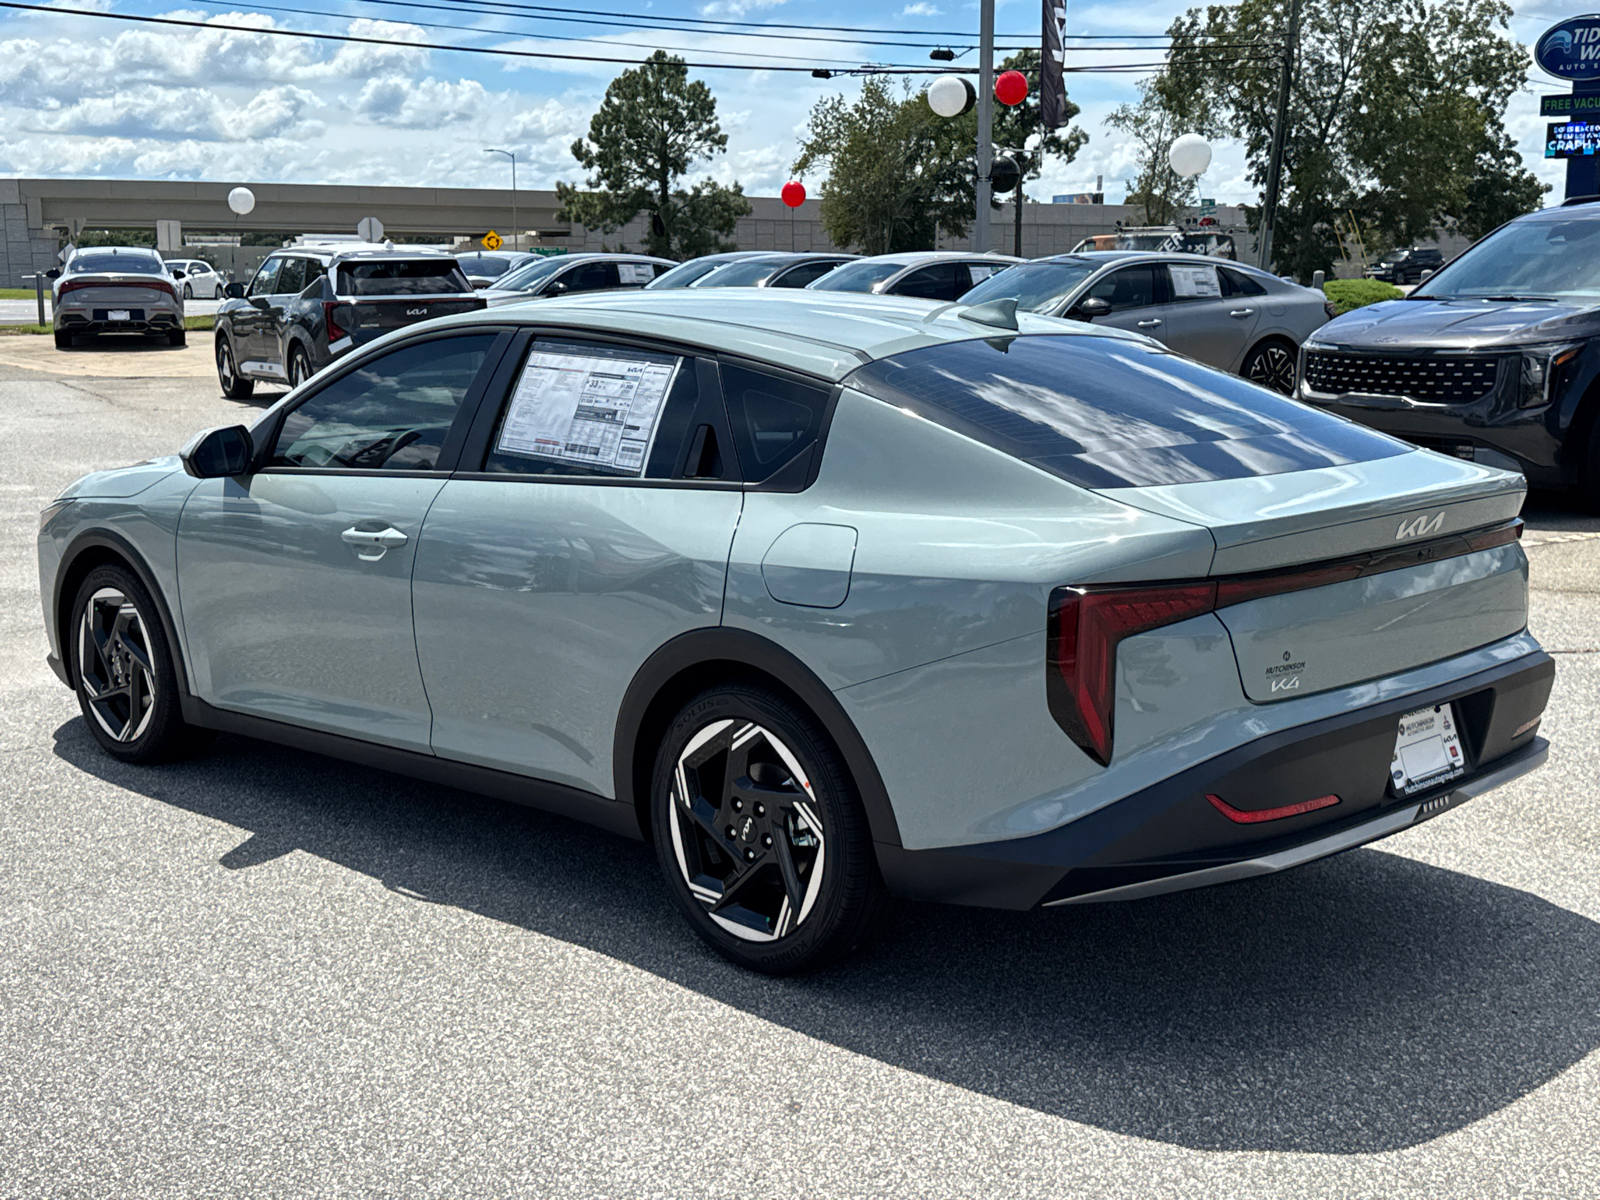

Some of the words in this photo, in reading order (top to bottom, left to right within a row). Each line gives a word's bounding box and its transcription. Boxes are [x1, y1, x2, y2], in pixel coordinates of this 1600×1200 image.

[1559, 63, 1586, 71] AUTO
[1544, 99, 1571, 110] FREE
[1395, 511, 1445, 540] KIA
[1265, 661, 1306, 675] HUTCHINSON
[1271, 676, 1299, 692] K4
[676, 698, 715, 731] SOLUS
[1443, 733, 1457, 743] KIA
[761, 939, 808, 965] KUMHO
